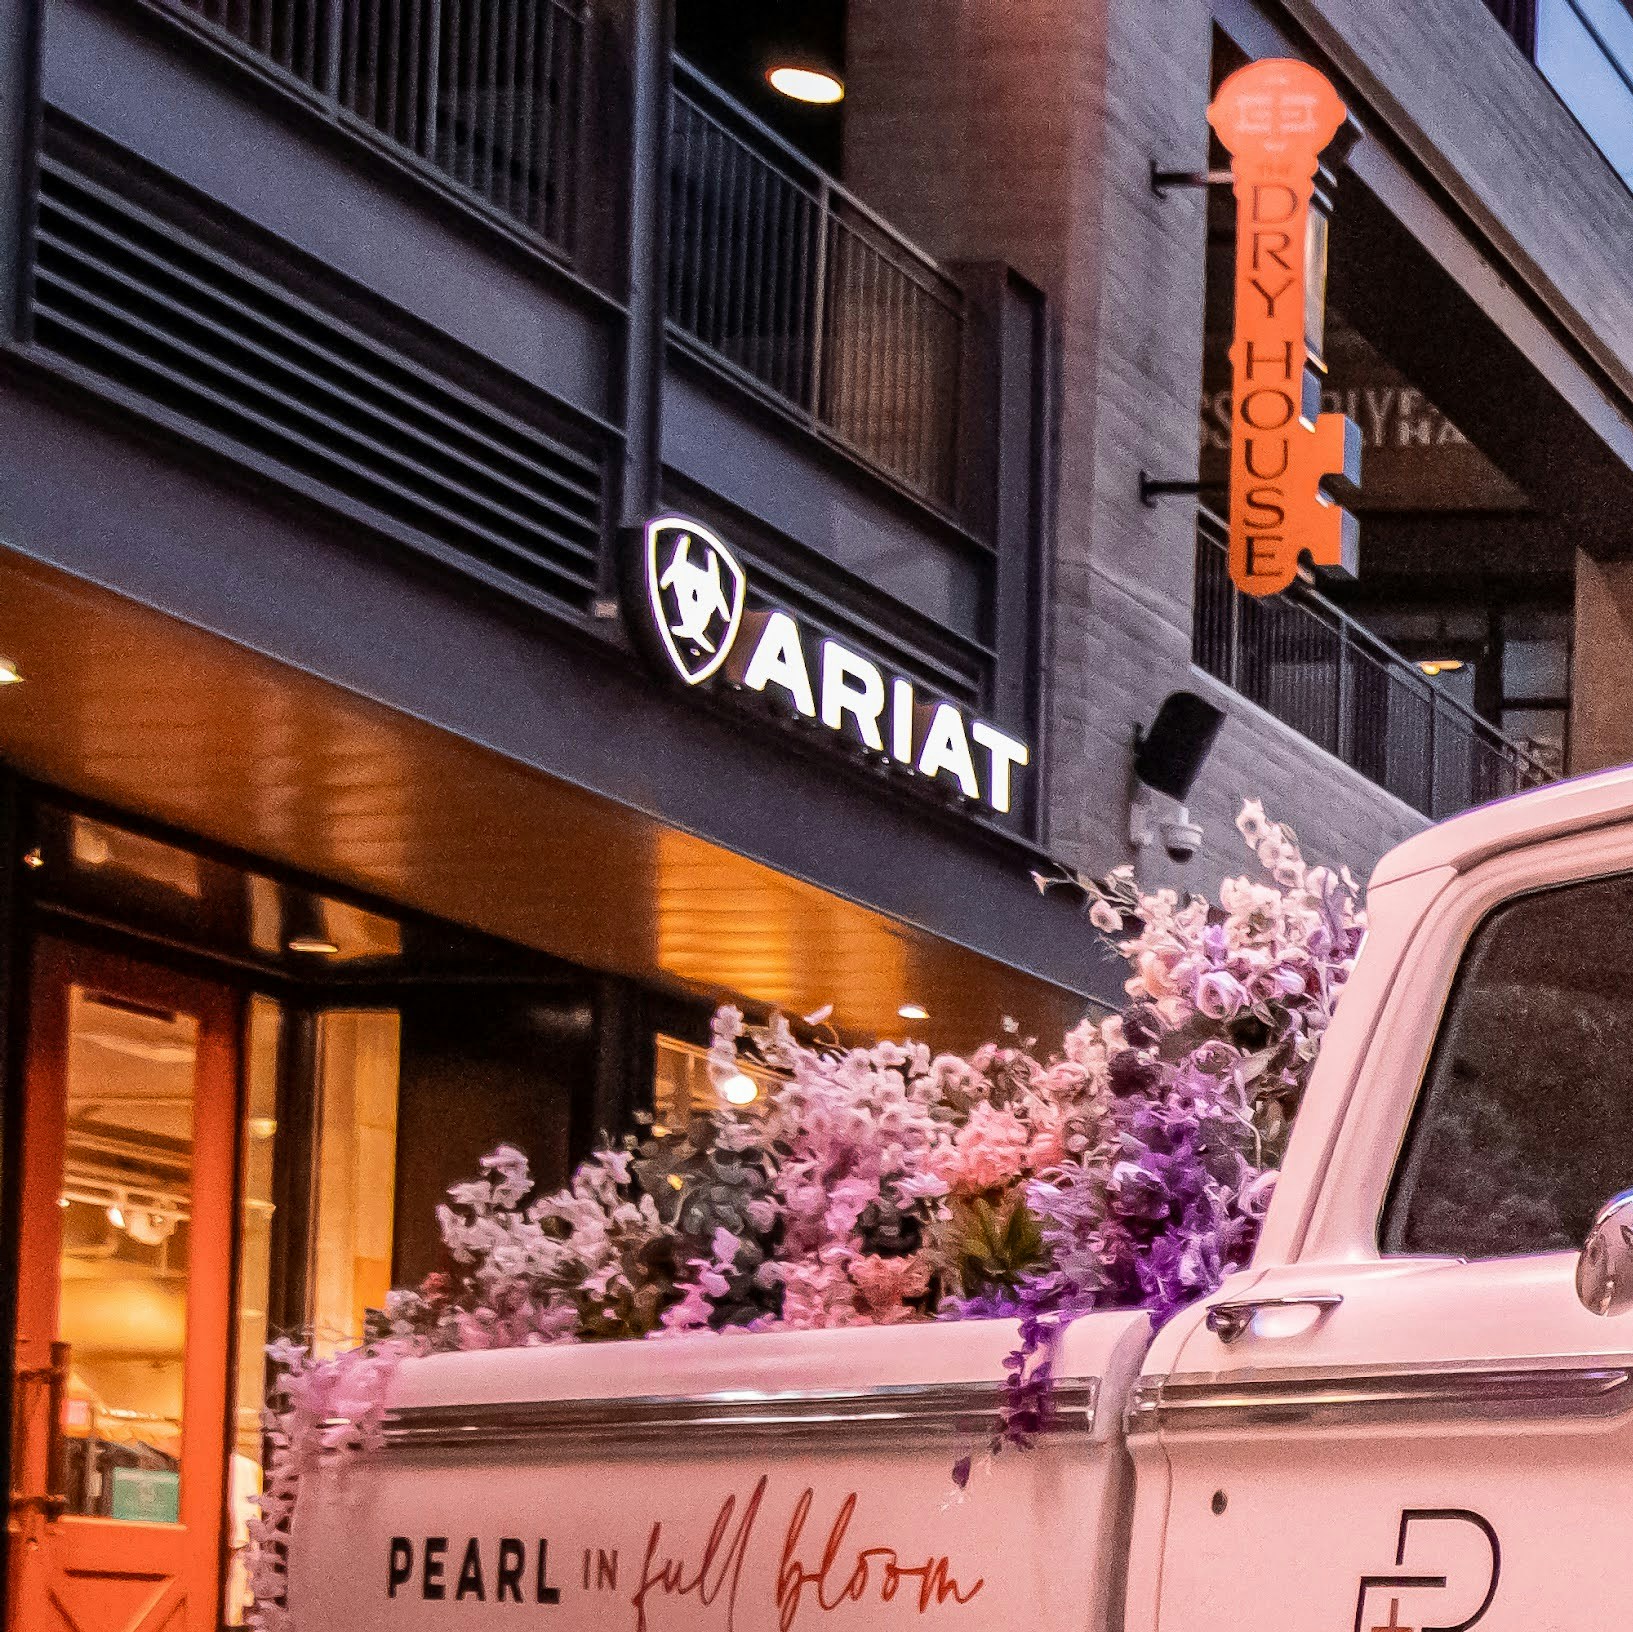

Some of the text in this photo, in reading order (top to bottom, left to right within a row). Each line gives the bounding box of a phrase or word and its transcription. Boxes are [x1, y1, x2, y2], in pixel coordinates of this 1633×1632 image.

[1249, 183, 1299, 318] DRY
[1240, 341, 1296, 578] HOUSE
[743, 610, 1029, 813] ARIAT
[387, 1537, 561, 1604] PEARL
[583, 1549, 618, 1591] IN
